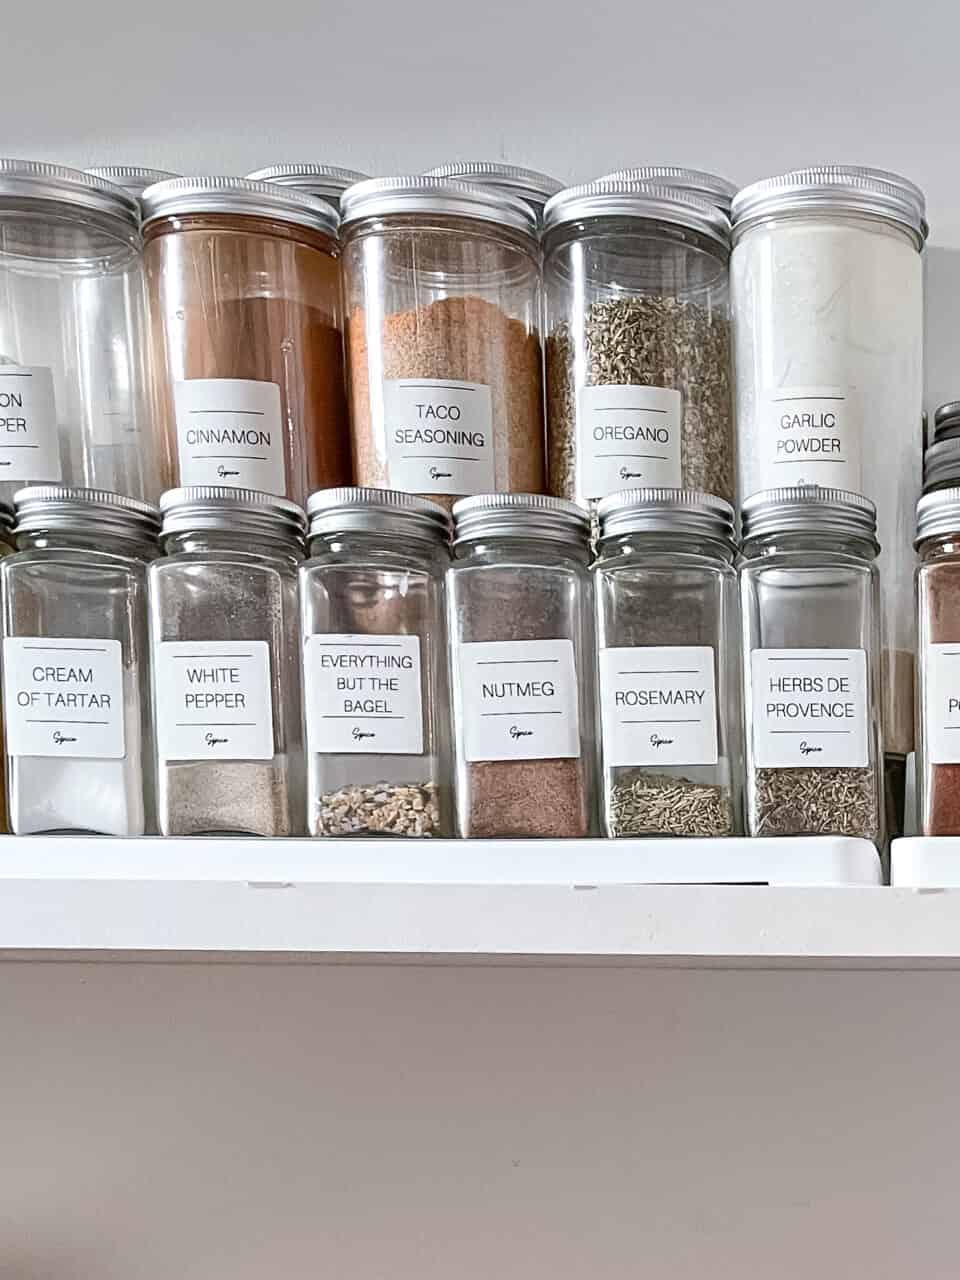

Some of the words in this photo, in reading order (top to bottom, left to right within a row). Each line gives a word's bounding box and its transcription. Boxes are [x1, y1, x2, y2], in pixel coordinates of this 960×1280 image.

[416, 405, 460, 420] TACO
[780, 413, 836, 429] GARLIC
[186, 429, 271, 447] CINNAMON
[394, 430, 485, 448] SEASONING
[593, 426, 669, 443] OREGANO
[777, 437, 841, 453] POWDER
[322, 655, 412, 668] EVERYTHING
[33, 667, 92, 682] CREAM
[187, 668, 239, 682] WHITE
[338, 678, 364, 689] BUT
[368, 678, 398, 690] THE
[483, 682, 554, 697] NUTMEG
[770, 678, 823, 692] HERBS
[828, 678, 849, 692] DE
[17, 692, 40, 706] OF
[45, 693, 110, 707] TARTAR
[186, 693, 245, 708] PEPPER
[616, 691, 704, 705] ROSEMARY
[345, 700, 392, 712] BAGEL
[767, 703, 854, 717] PROVENCE
